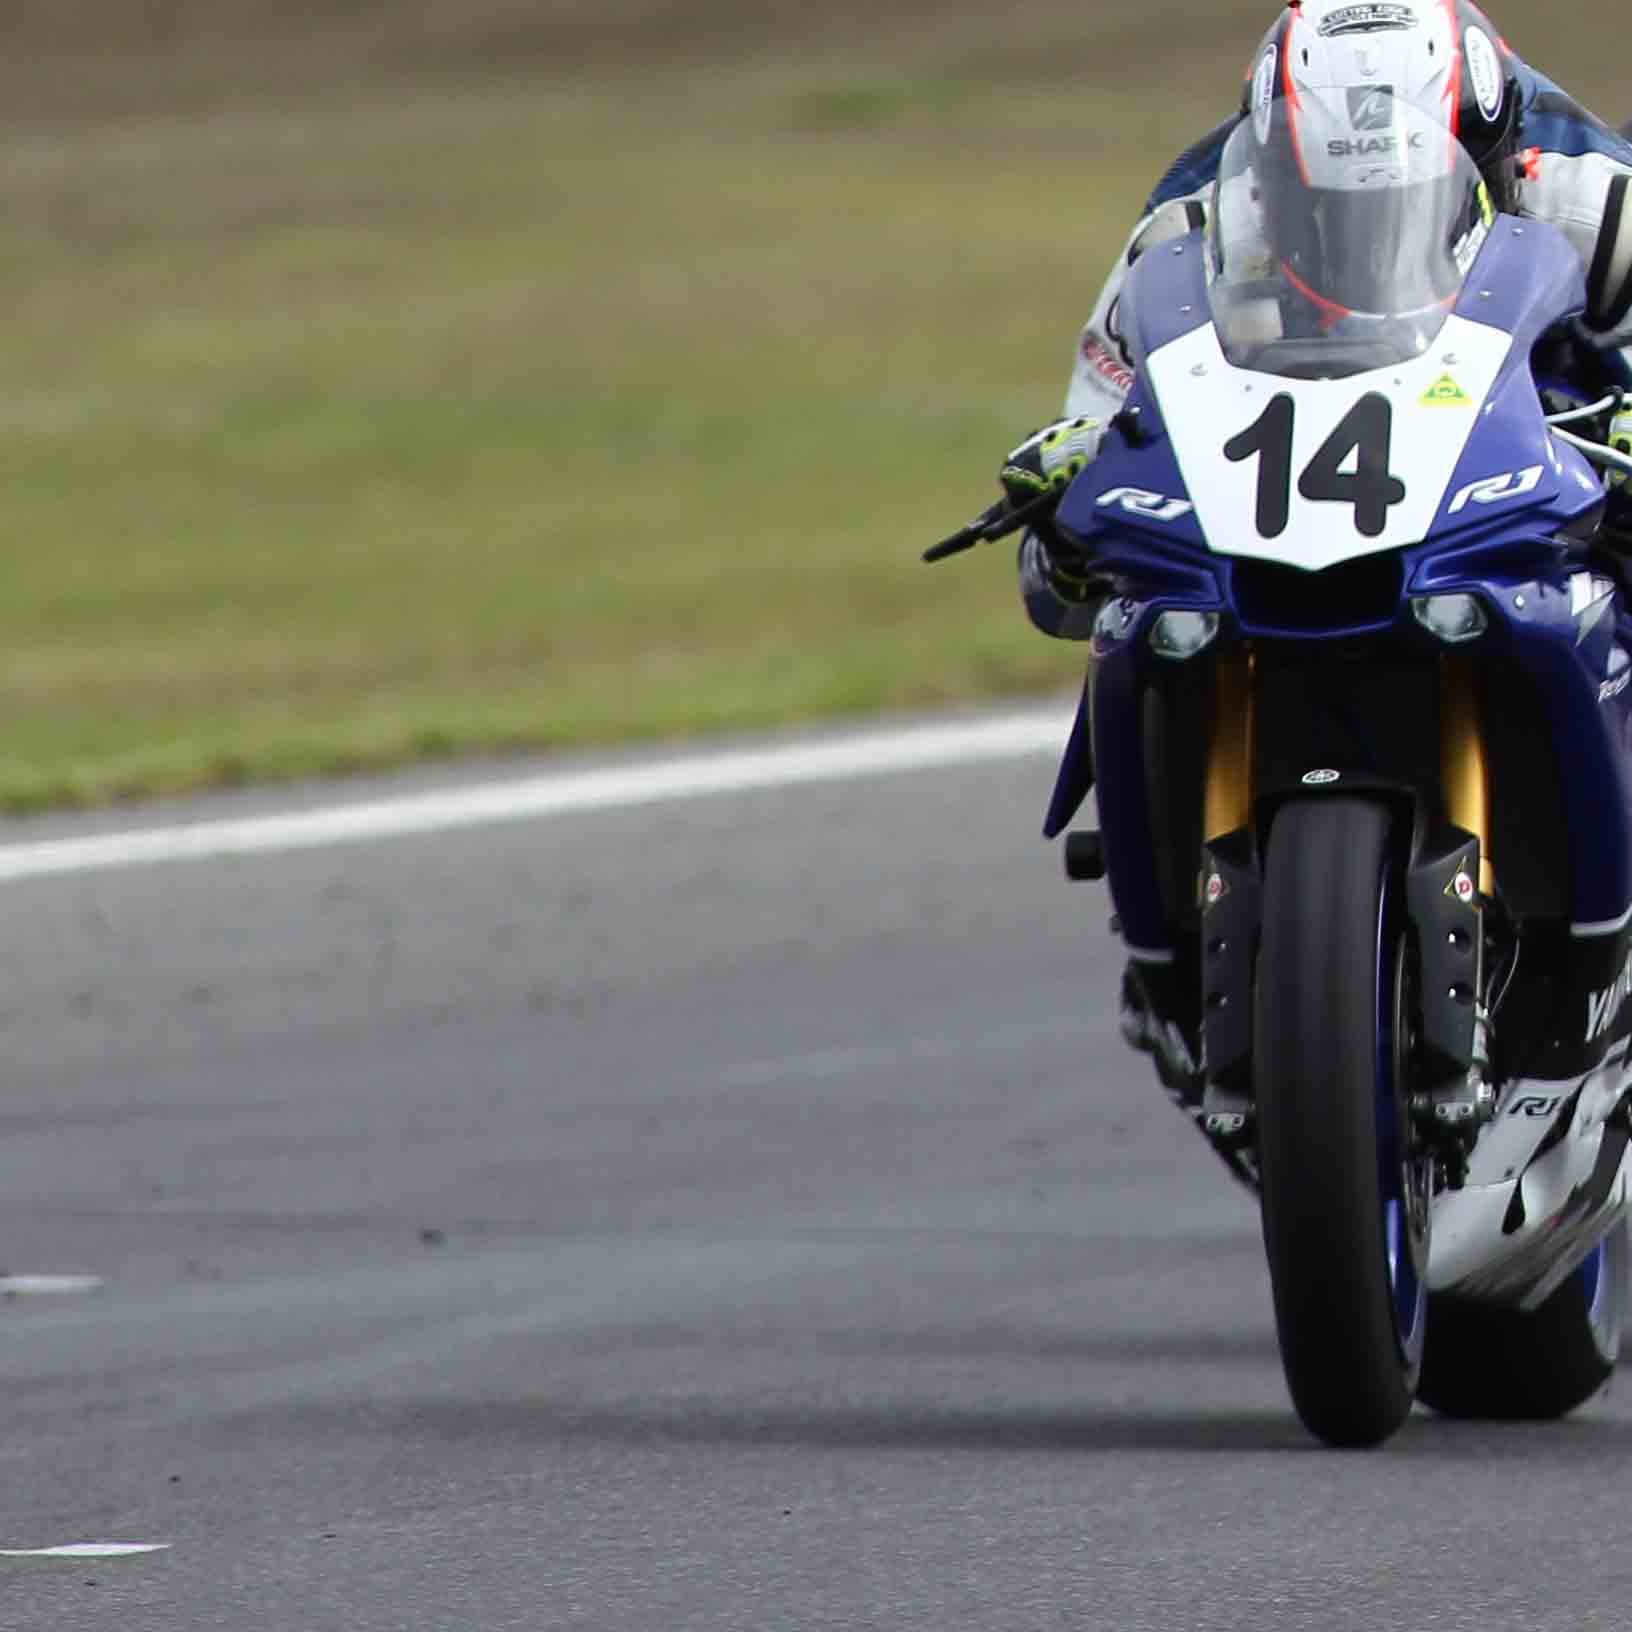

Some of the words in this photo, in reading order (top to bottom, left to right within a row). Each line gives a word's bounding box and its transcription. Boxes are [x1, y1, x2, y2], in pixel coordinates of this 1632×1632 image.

[1327, 132, 1425, 157] SHARK
[1223, 391, 1406, 539] 14
[1447, 464, 1545, 515] R1
[1507, 1096, 1561, 1117] R1
